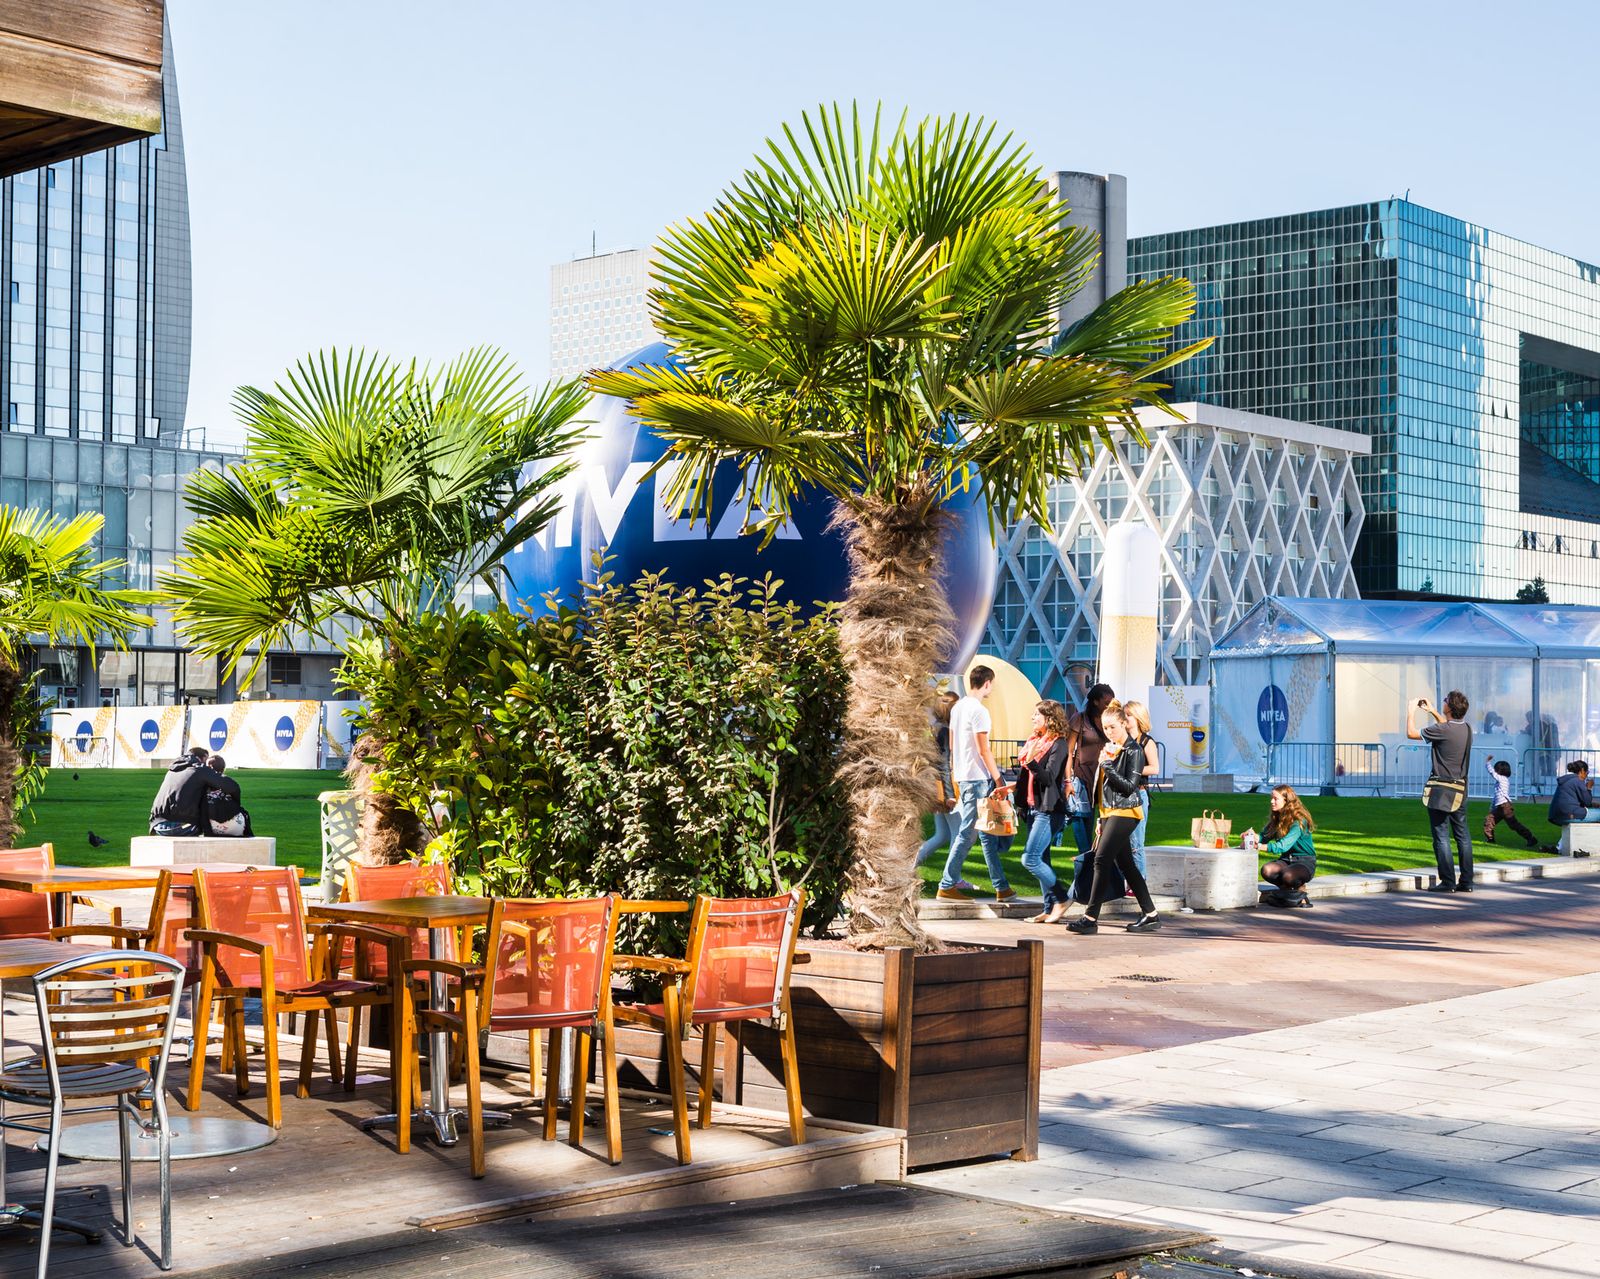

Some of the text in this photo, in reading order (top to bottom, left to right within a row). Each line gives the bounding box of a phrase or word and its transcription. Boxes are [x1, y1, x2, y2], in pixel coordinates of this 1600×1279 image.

[1260, 710, 1286, 722] NIVEA
[141, 732, 158, 740] NIVEA
[276, 729, 293, 737] NIVEA
